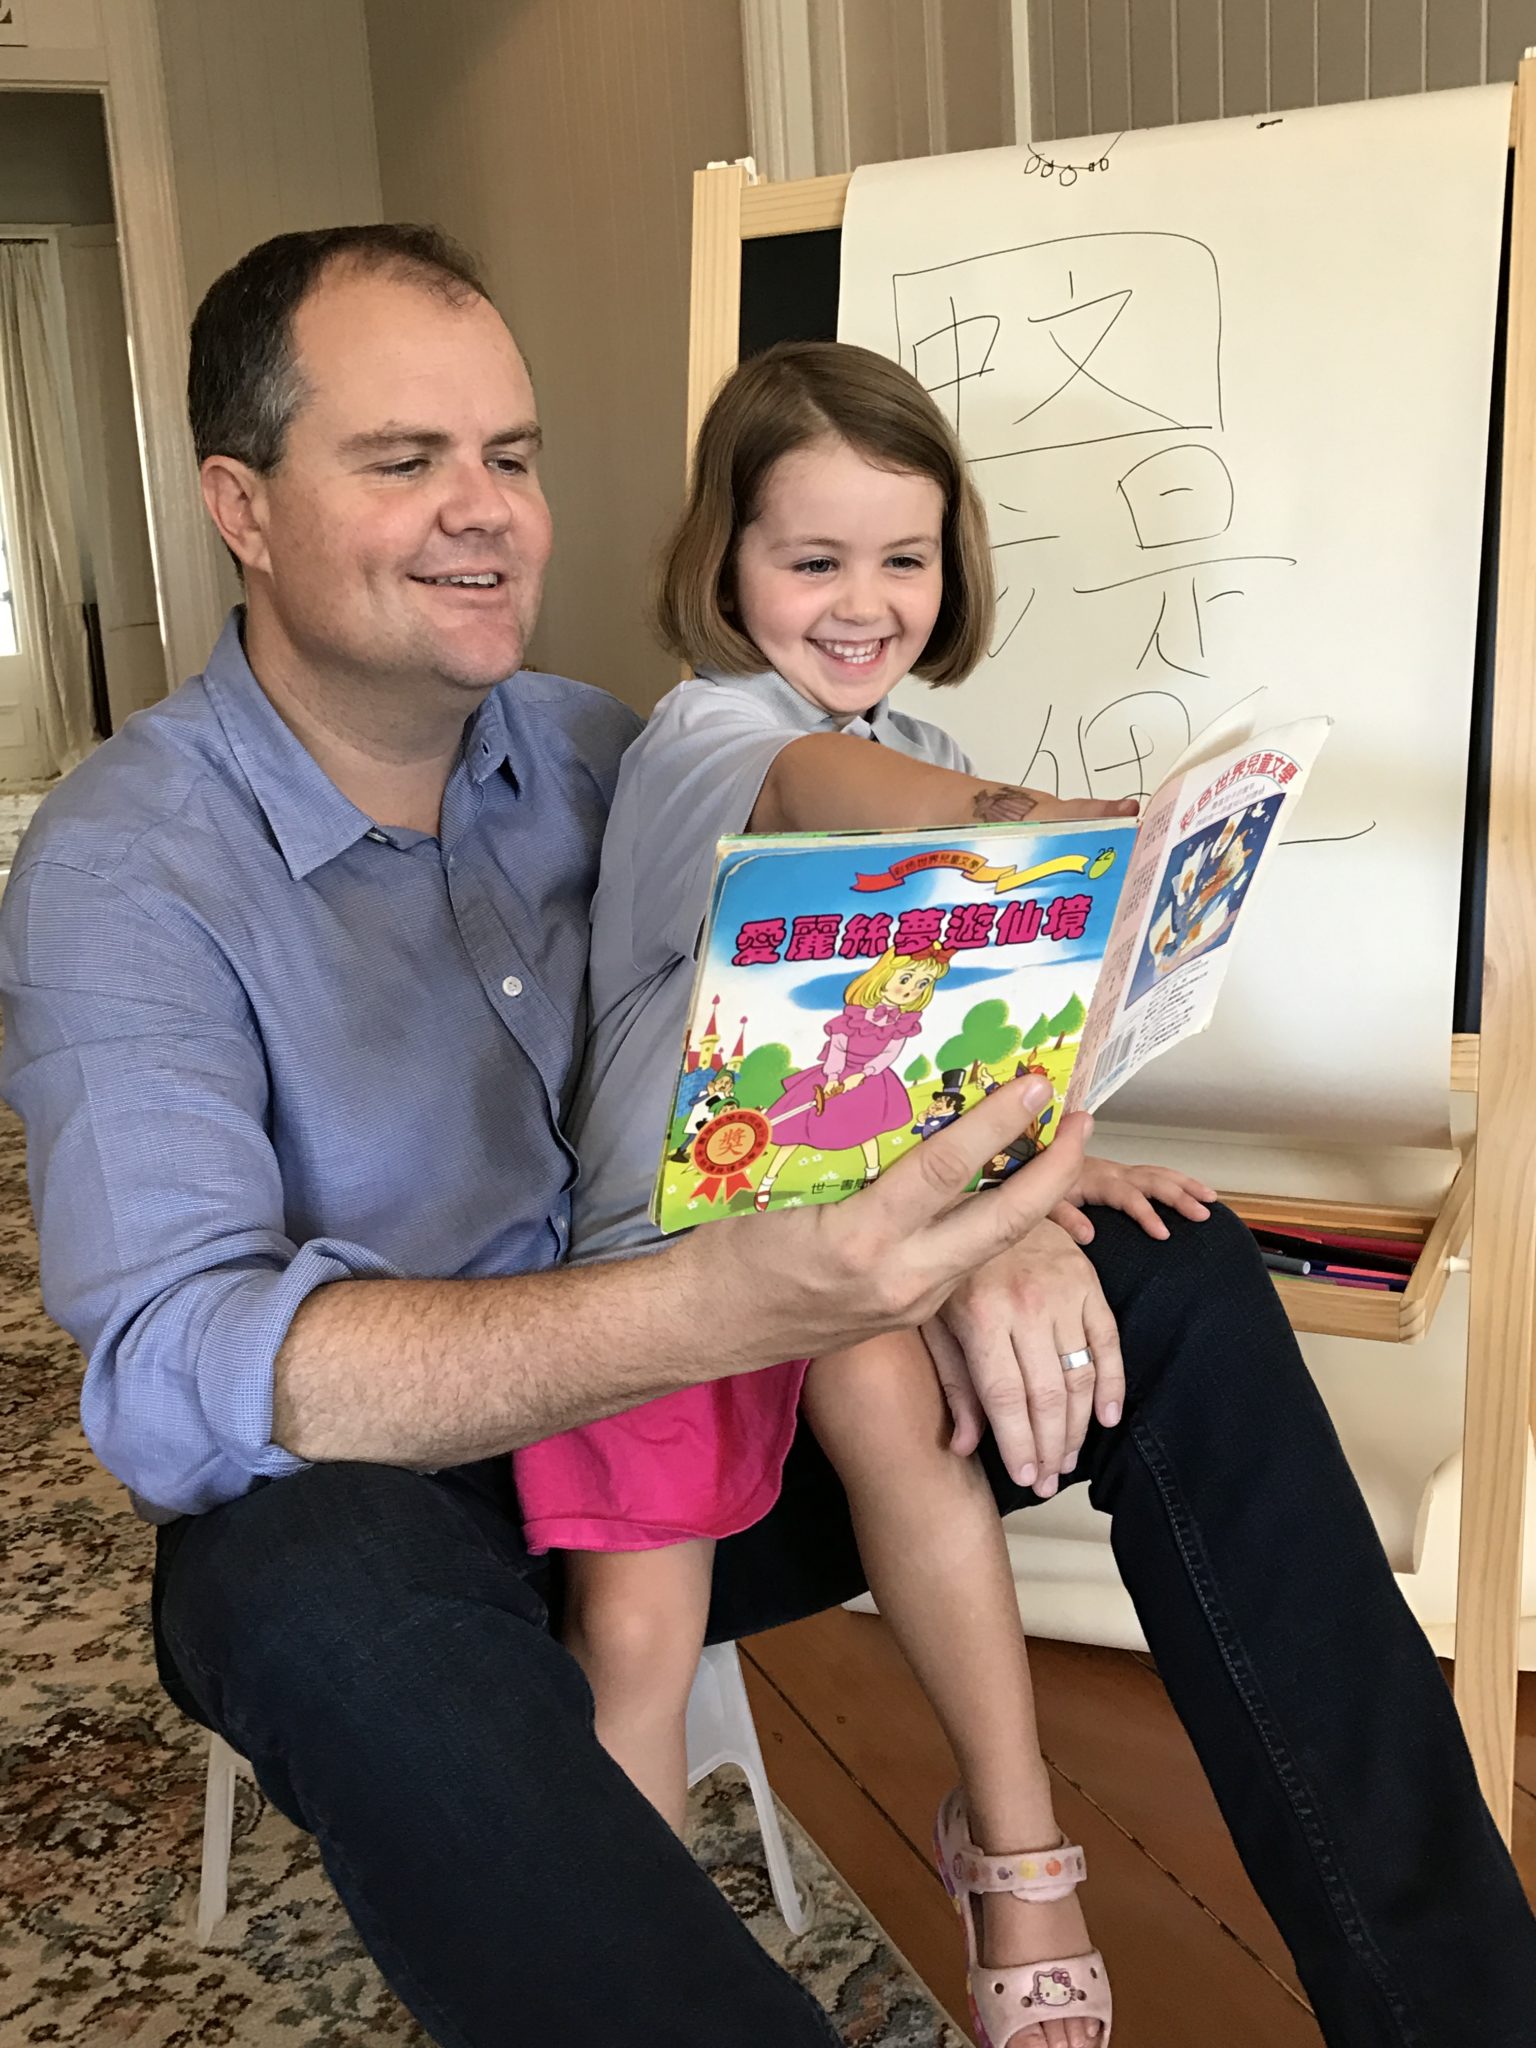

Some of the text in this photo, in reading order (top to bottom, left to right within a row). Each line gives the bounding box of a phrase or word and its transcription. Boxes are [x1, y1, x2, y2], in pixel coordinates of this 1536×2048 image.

[913, 270, 1190, 436] 中文
[731, 894, 1093, 967] 愛麗絲夢遊仙境
